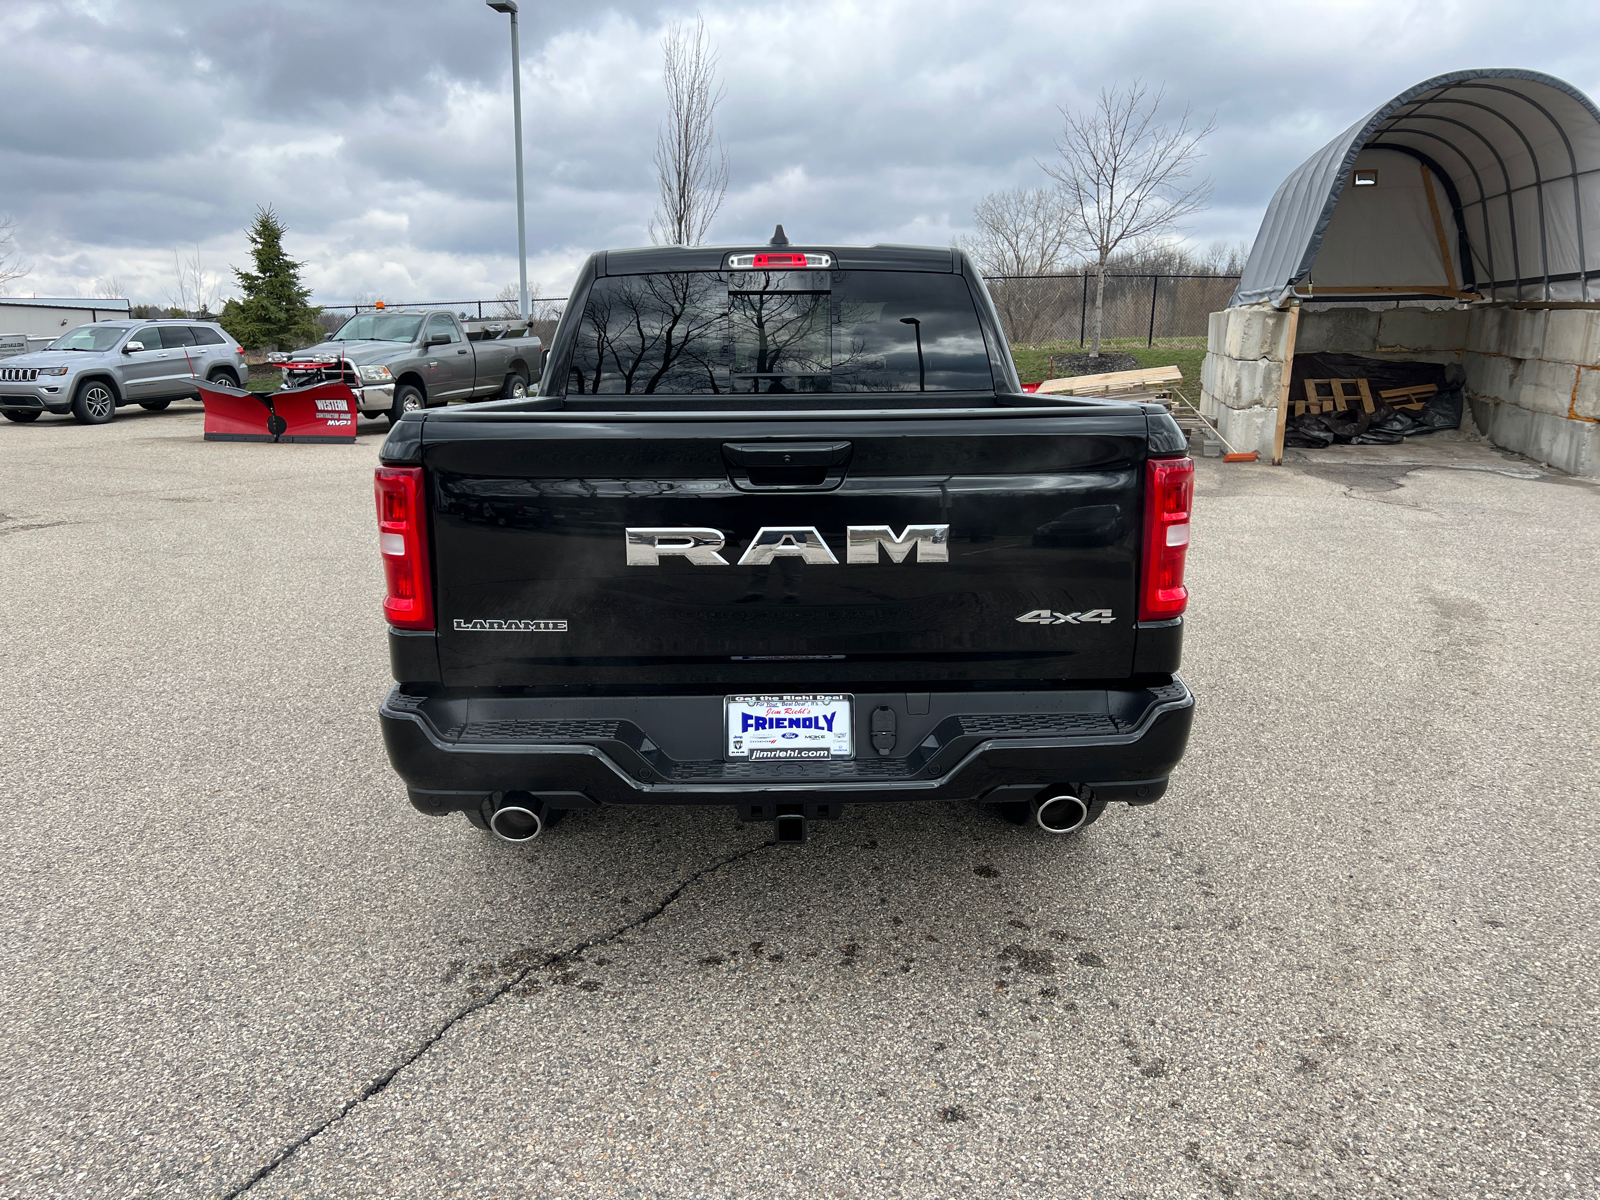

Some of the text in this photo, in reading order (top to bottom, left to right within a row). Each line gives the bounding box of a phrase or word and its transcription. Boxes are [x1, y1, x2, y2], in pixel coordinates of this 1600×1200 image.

[315, 400, 348, 410] WESTERN
[625, 524, 950, 566] RAM
[1015, 608, 1117, 625] 4x4
[453, 619, 568, 632] LARAMIE
[765, 707, 781, 717] Jim
[741, 711, 837, 734] FRIENDLY
[751, 750, 828, 759] jimriehl.com
